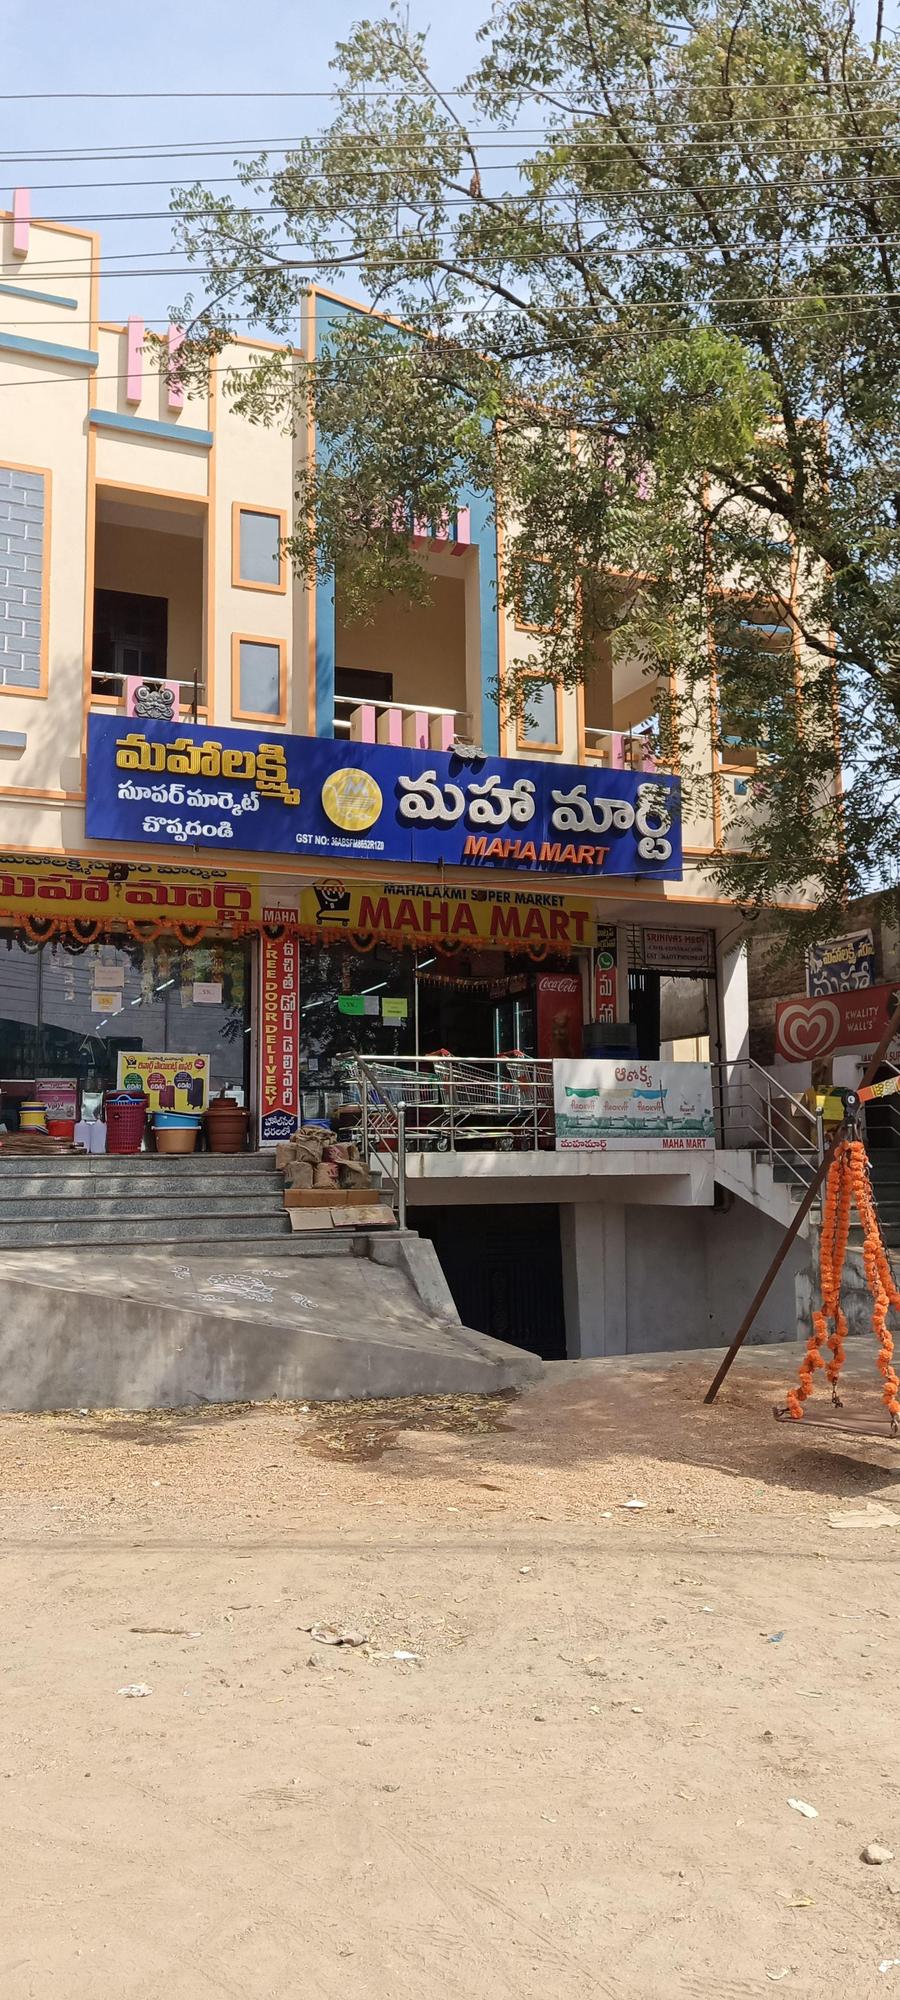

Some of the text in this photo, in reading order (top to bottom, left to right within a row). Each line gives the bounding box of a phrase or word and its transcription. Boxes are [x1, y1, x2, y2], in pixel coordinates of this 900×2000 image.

[115, 733, 301, 806] మహాలక్ష్మి
[117, 779, 261, 817] సూపర్ మార్కెట్
[142, 815, 234, 842] చొప్పదండి
[398, 769, 673, 861] మహా మార్ట్
[295, 833, 314, 844] GST
[314, 835, 330, 846] NO:
[463, 835, 610, 865] MAHA MART
[125, 879, 252, 923] మార్ట్
[383, 882, 466, 900] MAHALAXMI
[514, 892, 565, 907] MARKET
[264, 910, 297, 923] MAHA
[357, 895, 478, 936] MAHA
[489, 905, 589, 942] MART
[538, 976, 578, 992] Coca-Cola
[265, 982, 278, 1022] DOOR
[845, 1006, 880, 1020] KWALITY
[847, 1020, 873, 1032] WALL'S
[265, 1024, 278, 1106] DELIVERY
[662, 1138, 707, 1149] MAHA MART
